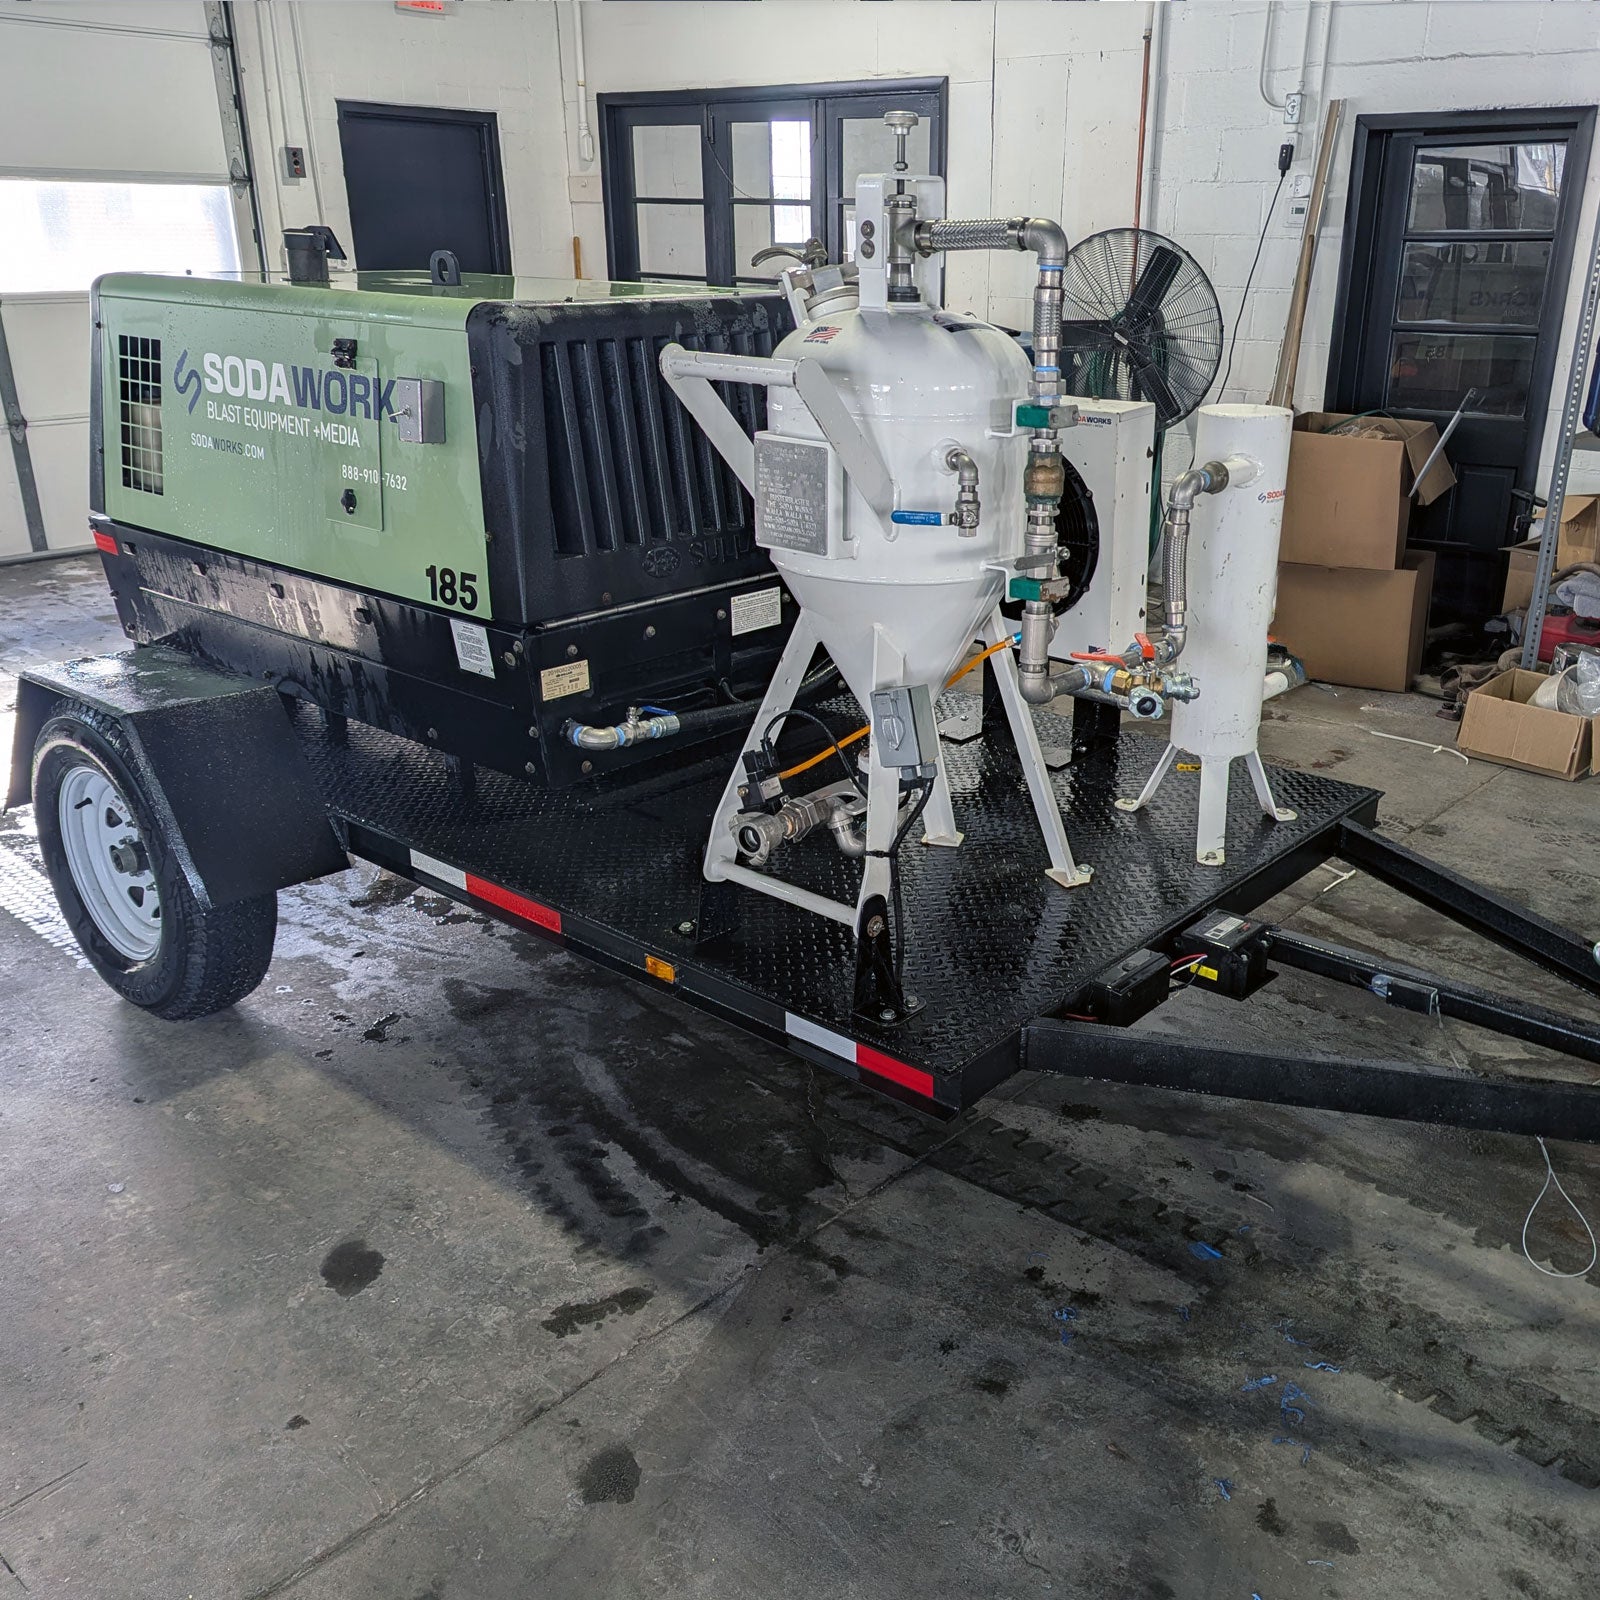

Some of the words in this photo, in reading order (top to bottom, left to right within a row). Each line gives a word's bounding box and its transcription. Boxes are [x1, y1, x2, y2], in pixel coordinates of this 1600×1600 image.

[203, 352, 398, 423] SODAWORK
[207, 400, 241, 424] BLAST
[244, 404, 310, 437] EQUIPMENT
[1076, 415, 1112, 425] DAWORKS
[190, 432, 266, 460] SODAWORKS.COM
[1266, 489, 1286, 499] SODA
[425, 564, 479, 611] 185
